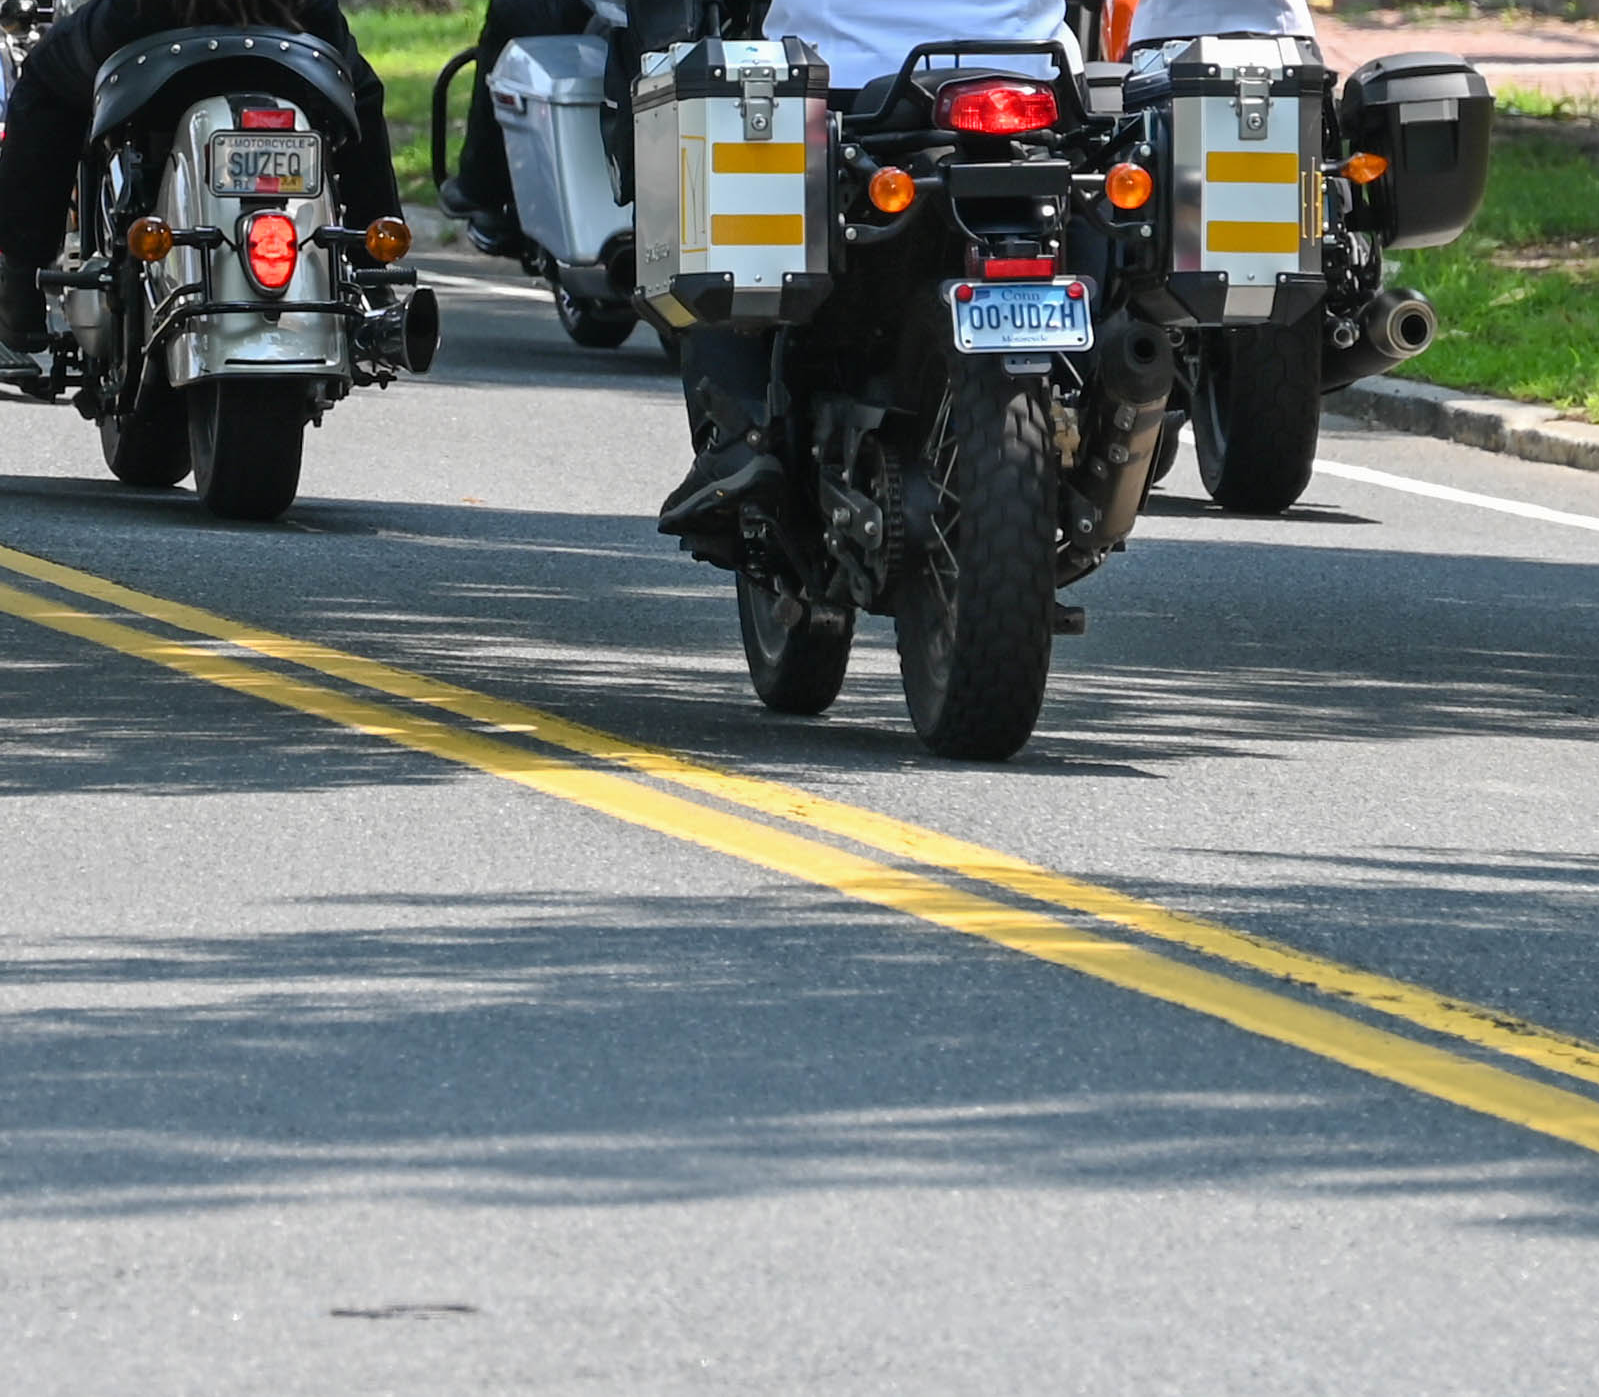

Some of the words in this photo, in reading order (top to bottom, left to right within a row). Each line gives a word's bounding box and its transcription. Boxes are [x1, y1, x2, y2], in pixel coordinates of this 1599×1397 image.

[234, 138, 305, 149] MOTORCYCLE
[231, 152, 301, 177] SUZEQ
[1001, 289, 1041, 302] Conn
